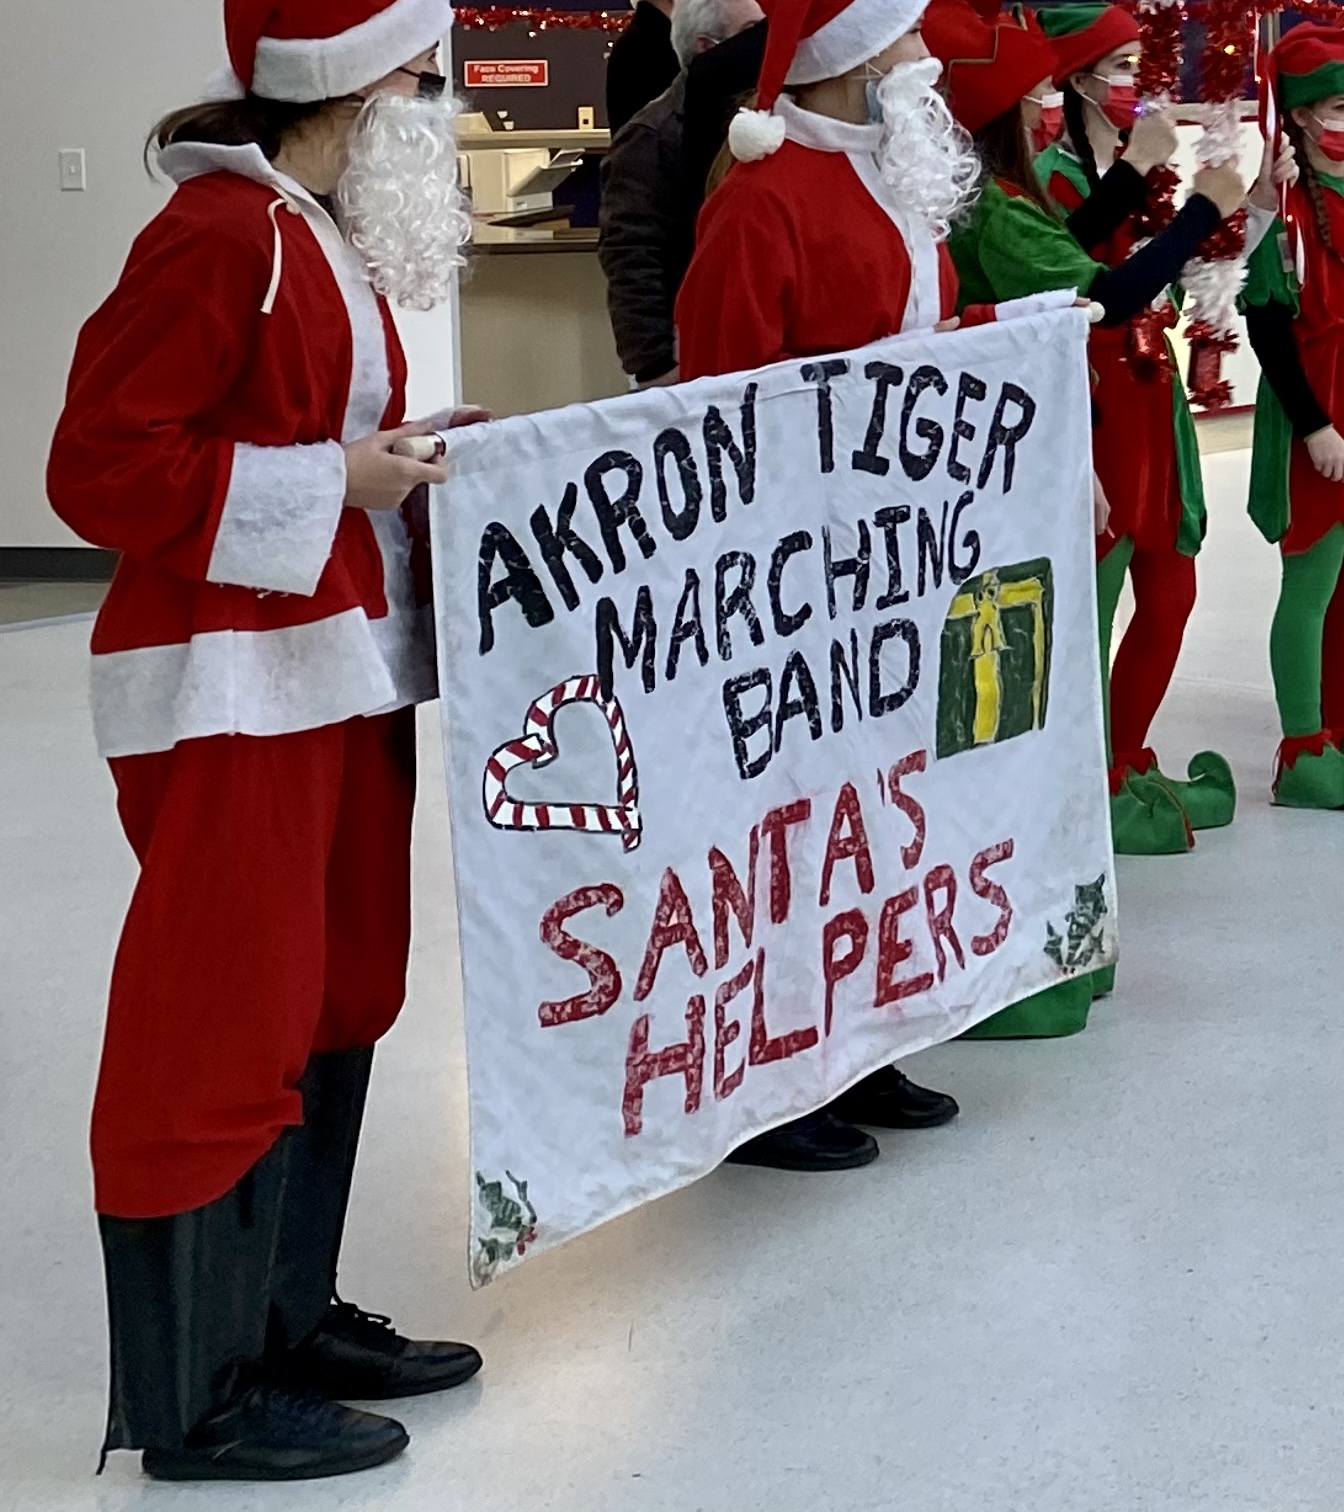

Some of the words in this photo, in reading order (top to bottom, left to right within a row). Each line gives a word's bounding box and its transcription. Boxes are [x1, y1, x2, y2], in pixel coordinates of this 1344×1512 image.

[474, 64, 496, 73] Face
[498, 64, 539, 74] Covering
[481, 74, 531, 83] REQUIRED
[477, 381, 759, 657] AKRON
[799, 359, 1036, 494] TIGER
[598, 489, 982, 703] MARCHING
[722, 616, 922, 781] BAND
[537, 747, 930, 1028] SANTA'S
[622, 836, 1015, 1137] HELPERS
